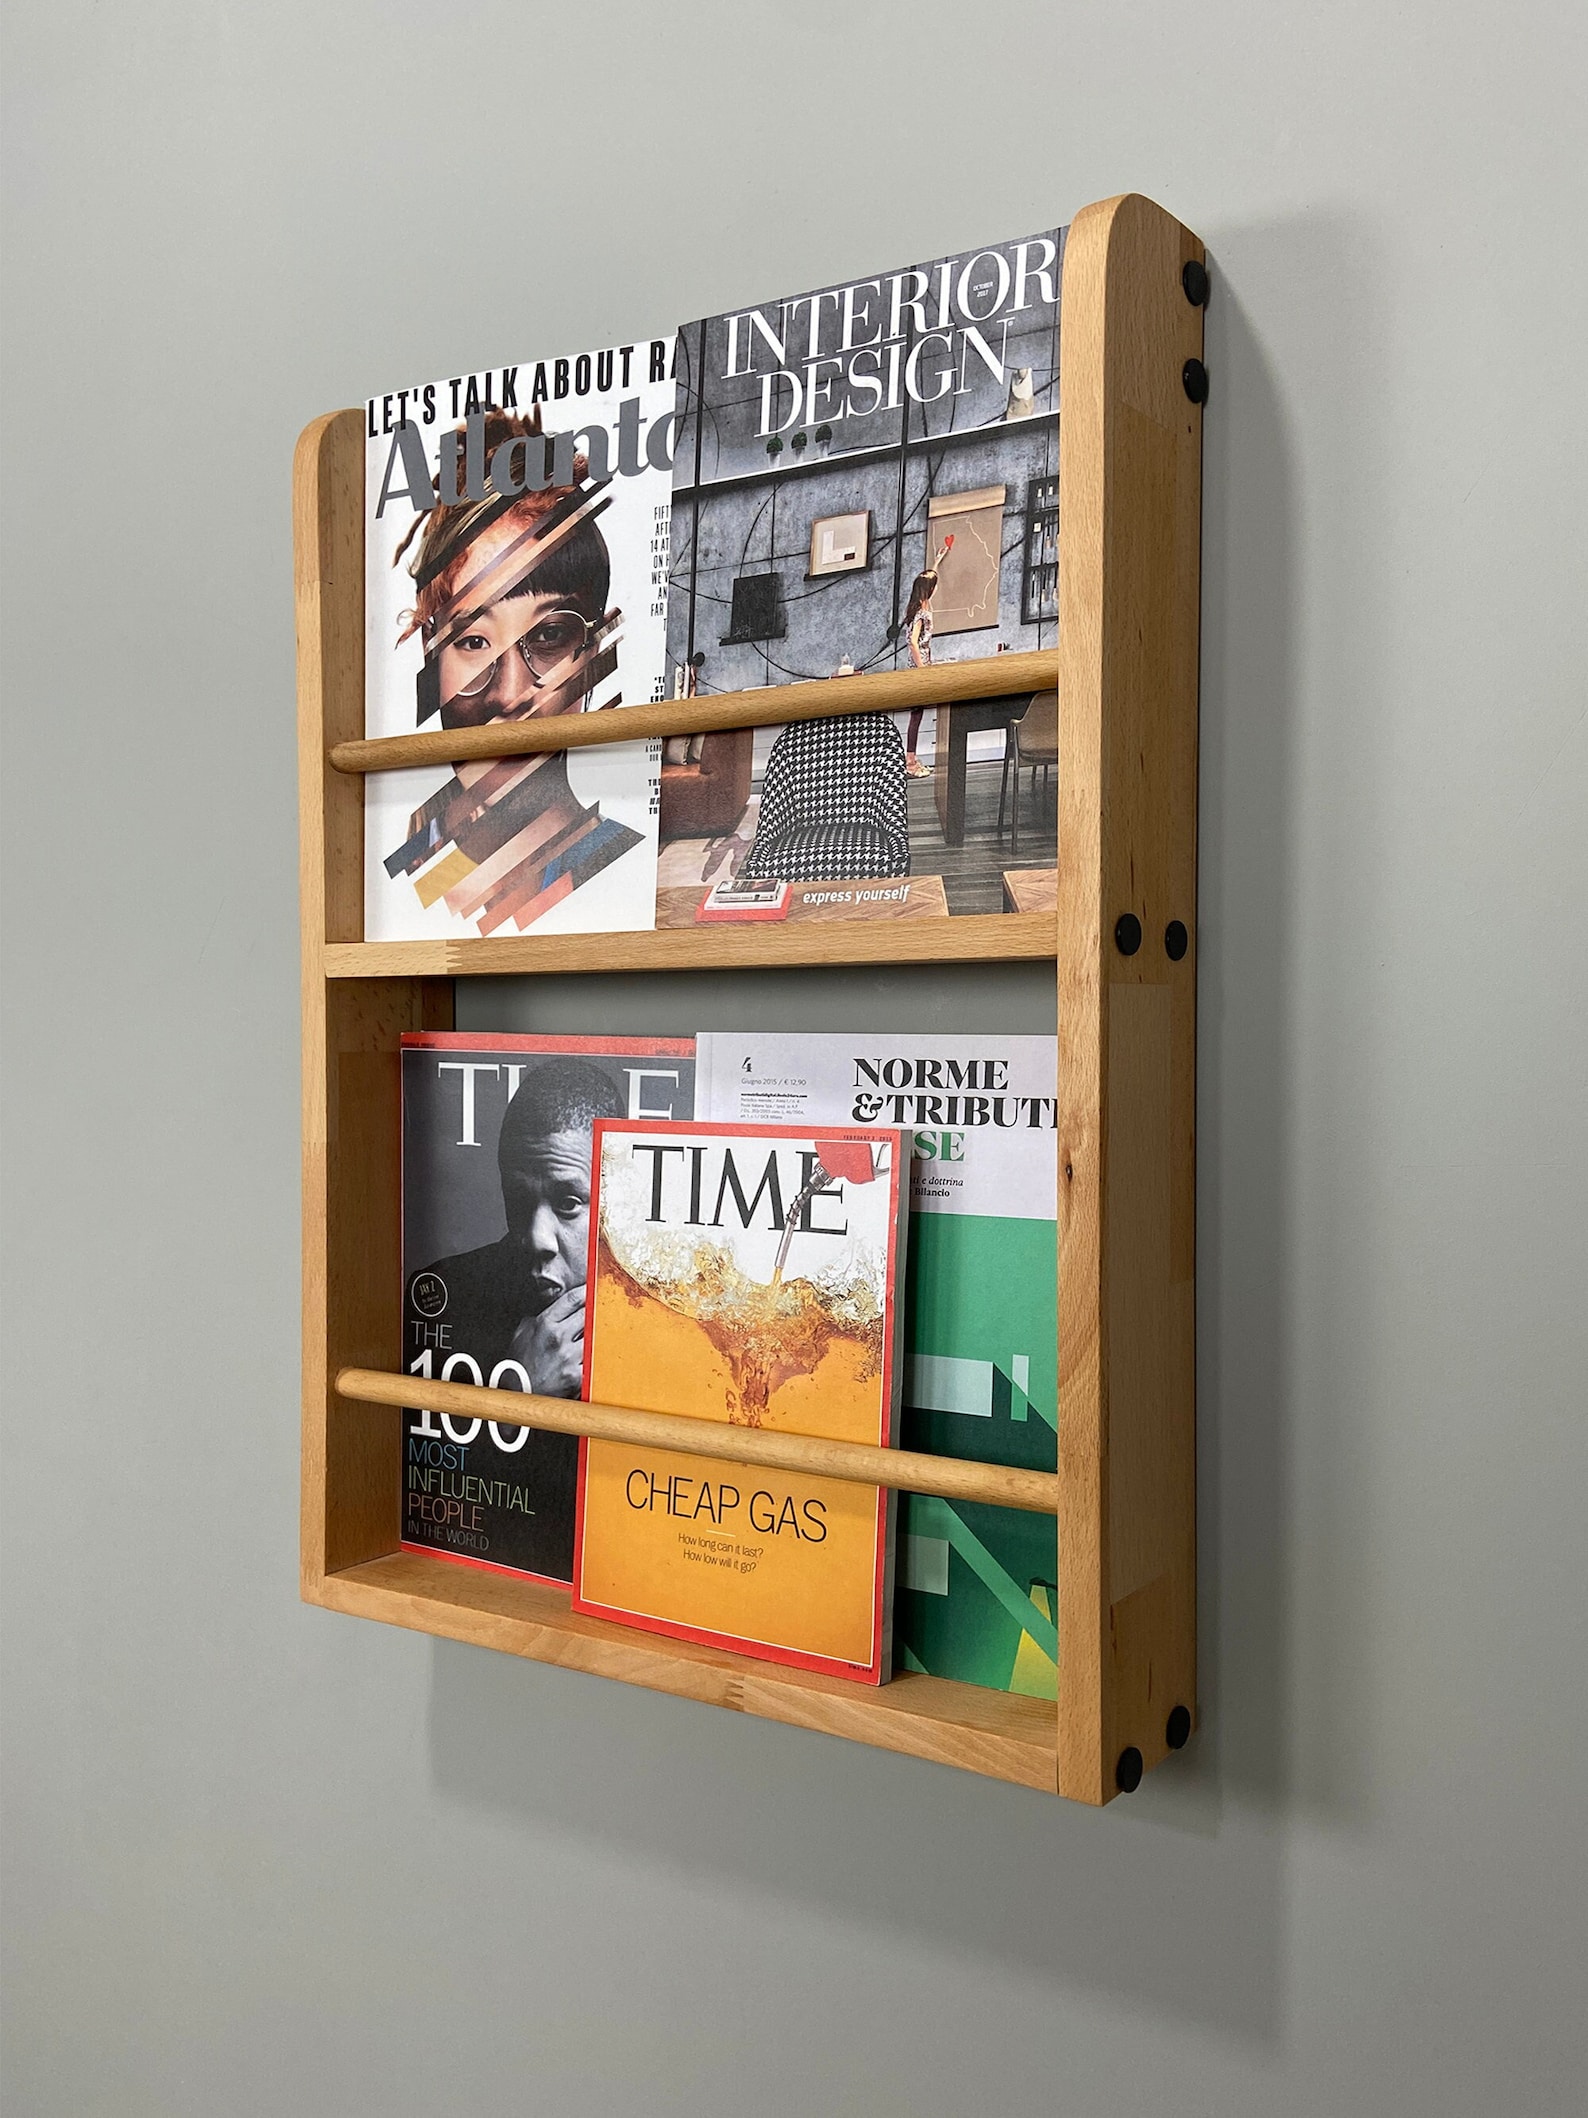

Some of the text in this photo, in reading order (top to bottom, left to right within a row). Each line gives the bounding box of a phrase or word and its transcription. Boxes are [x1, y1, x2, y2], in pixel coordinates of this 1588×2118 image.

[722, 238, 1060, 380] INTERIOR
[368, 384, 436, 438] LET'S
[449, 366, 518, 418] TALK
[531, 346, 634, 404] ABOUT
[754, 317, 1015, 438] DESIGN
[653, 554, 664, 569] ON
[651, 603, 664, 617] FAR
[803, 884, 911, 908] express yourself
[741, 1056, 753, 1073] 4
[852, 1057, 1009, 1091] NORME
[632, 1144, 848, 1235] TIME
[410, 1320, 453, 1350] THE
[410, 1349, 532, 1453] 100
[408, 1438, 470, 1471] MOST
[408, 1465, 536, 1515] INFLUENTIAL
[626, 1469, 827, 1543] CHEAP GAS
[408, 1492, 485, 1532] PEOPLE
[408, 1520, 490, 1551] IN THE WORLD
[678, 1533, 697, 1545] How
[698, 1537, 716, 1552] long
[717, 1542, 734, 1552] can
[742, 1546, 764, 1558] last?
[683, 1549, 702, 1561] How
[704, 1553, 718, 1565] low
[740, 1561, 757, 1574] go?
